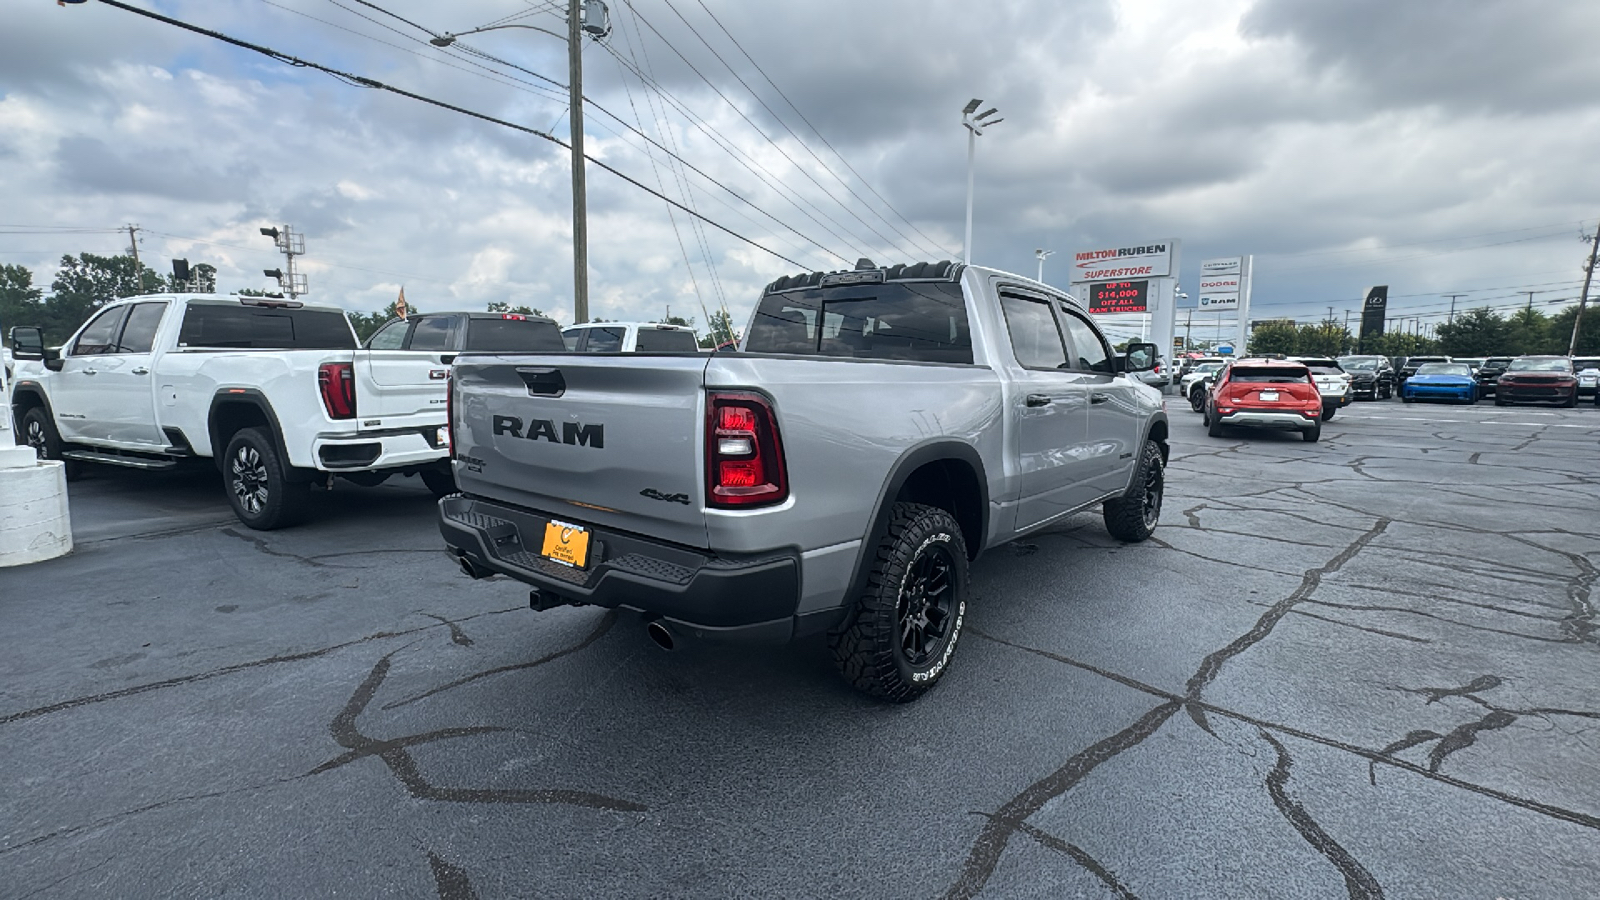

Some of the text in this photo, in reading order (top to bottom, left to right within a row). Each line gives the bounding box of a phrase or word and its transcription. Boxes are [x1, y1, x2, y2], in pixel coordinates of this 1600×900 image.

[1084, 266, 1153, 279] SUPERSTORE
[1098, 289, 1138, 299] $14,000
[492, 414, 604, 449] RAM
